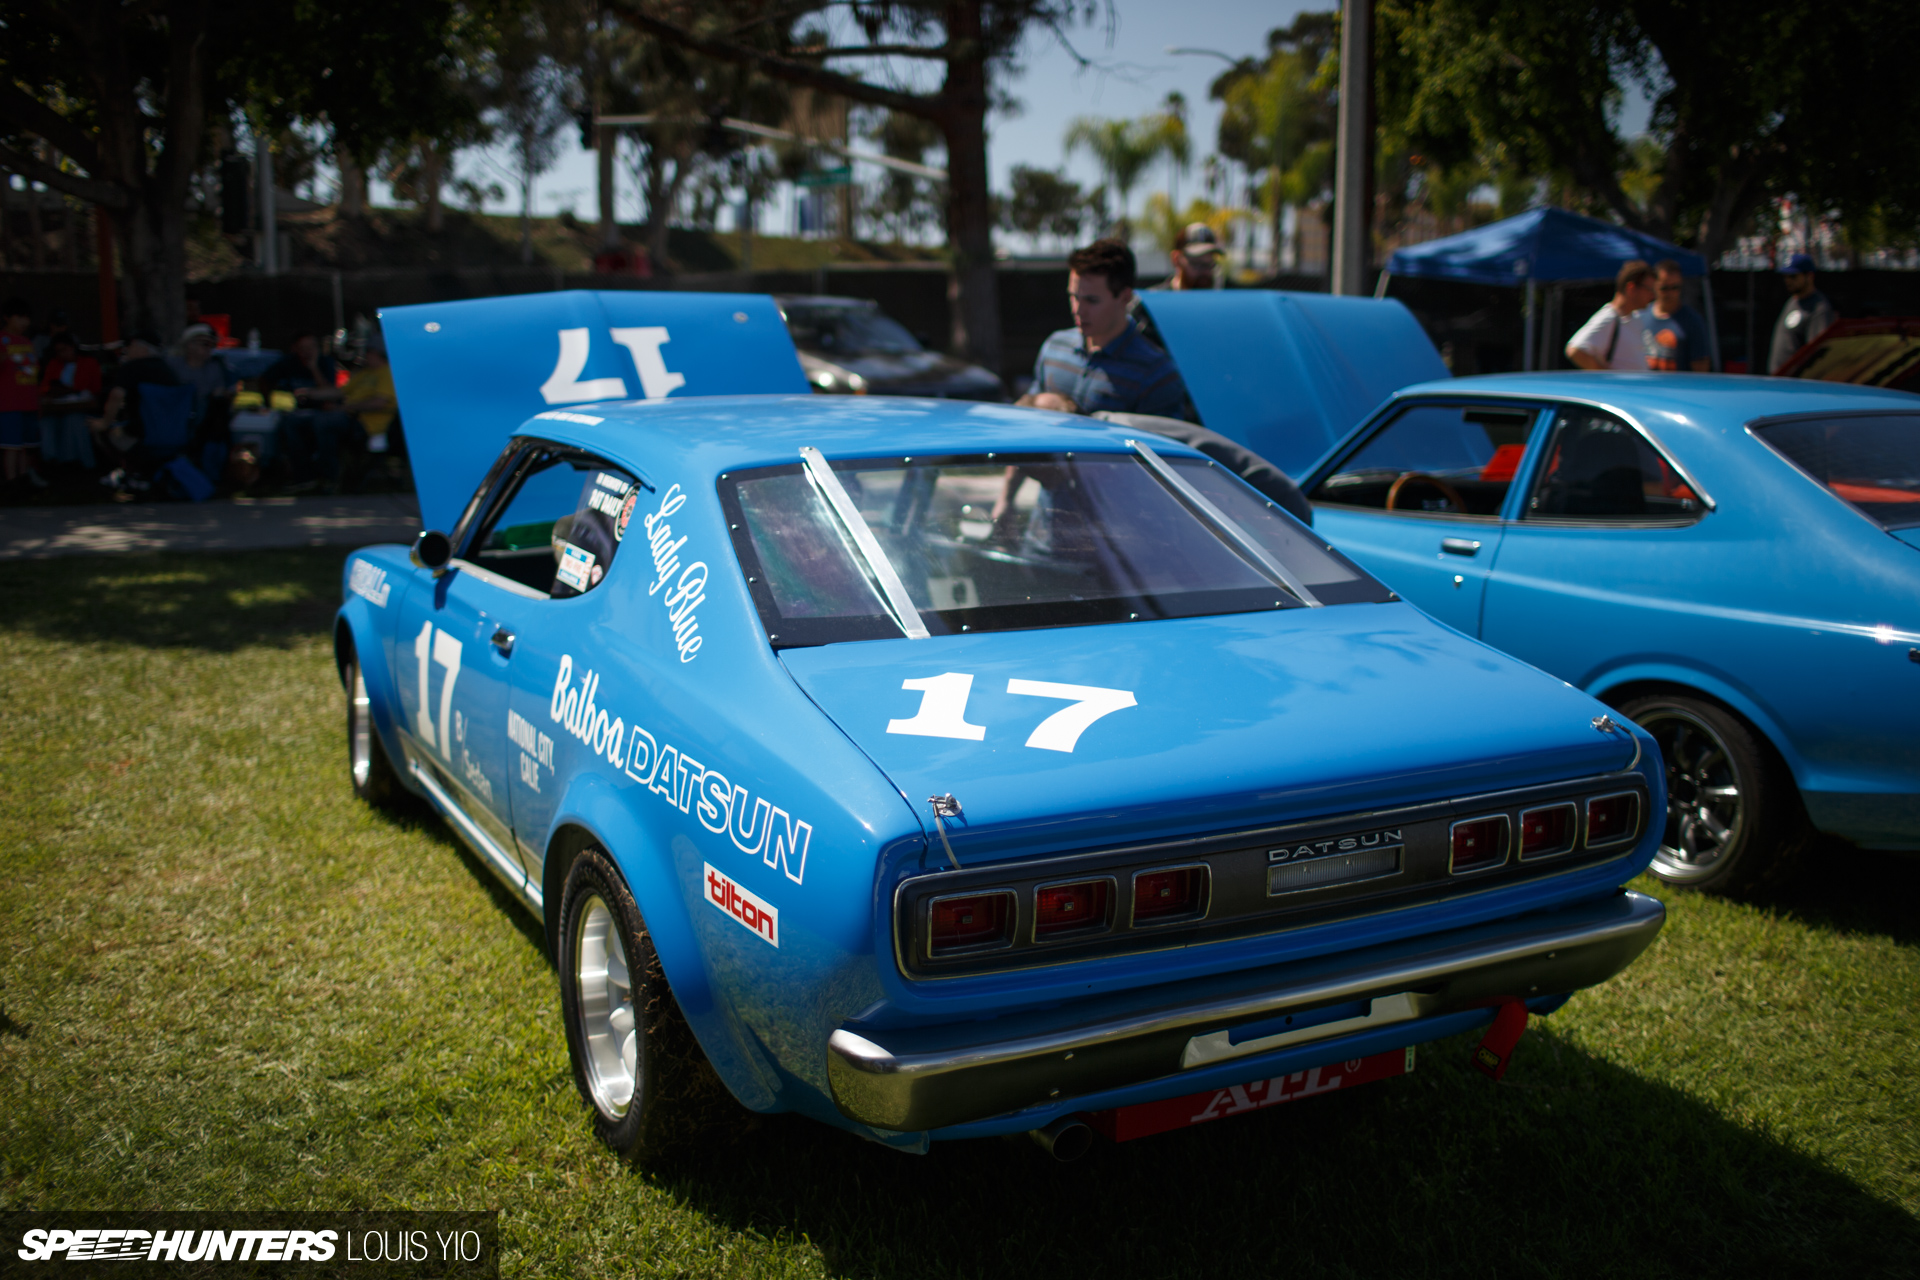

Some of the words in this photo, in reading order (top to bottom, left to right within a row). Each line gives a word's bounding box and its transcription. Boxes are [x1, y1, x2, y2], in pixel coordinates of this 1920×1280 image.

[539, 326, 686, 405] 17
[644, 483, 688, 596] Lady
[664, 561, 708, 663] Blue
[415, 620, 463, 764] 17
[886, 672, 1138, 753] 17
[507, 708, 538, 758] NATIONAL
[550, 654, 625, 769] Balboa
[625, 725, 813, 886] DATSUN
[1268, 829, 1402, 861] DATSUN
[707, 870, 774, 941] tilton
